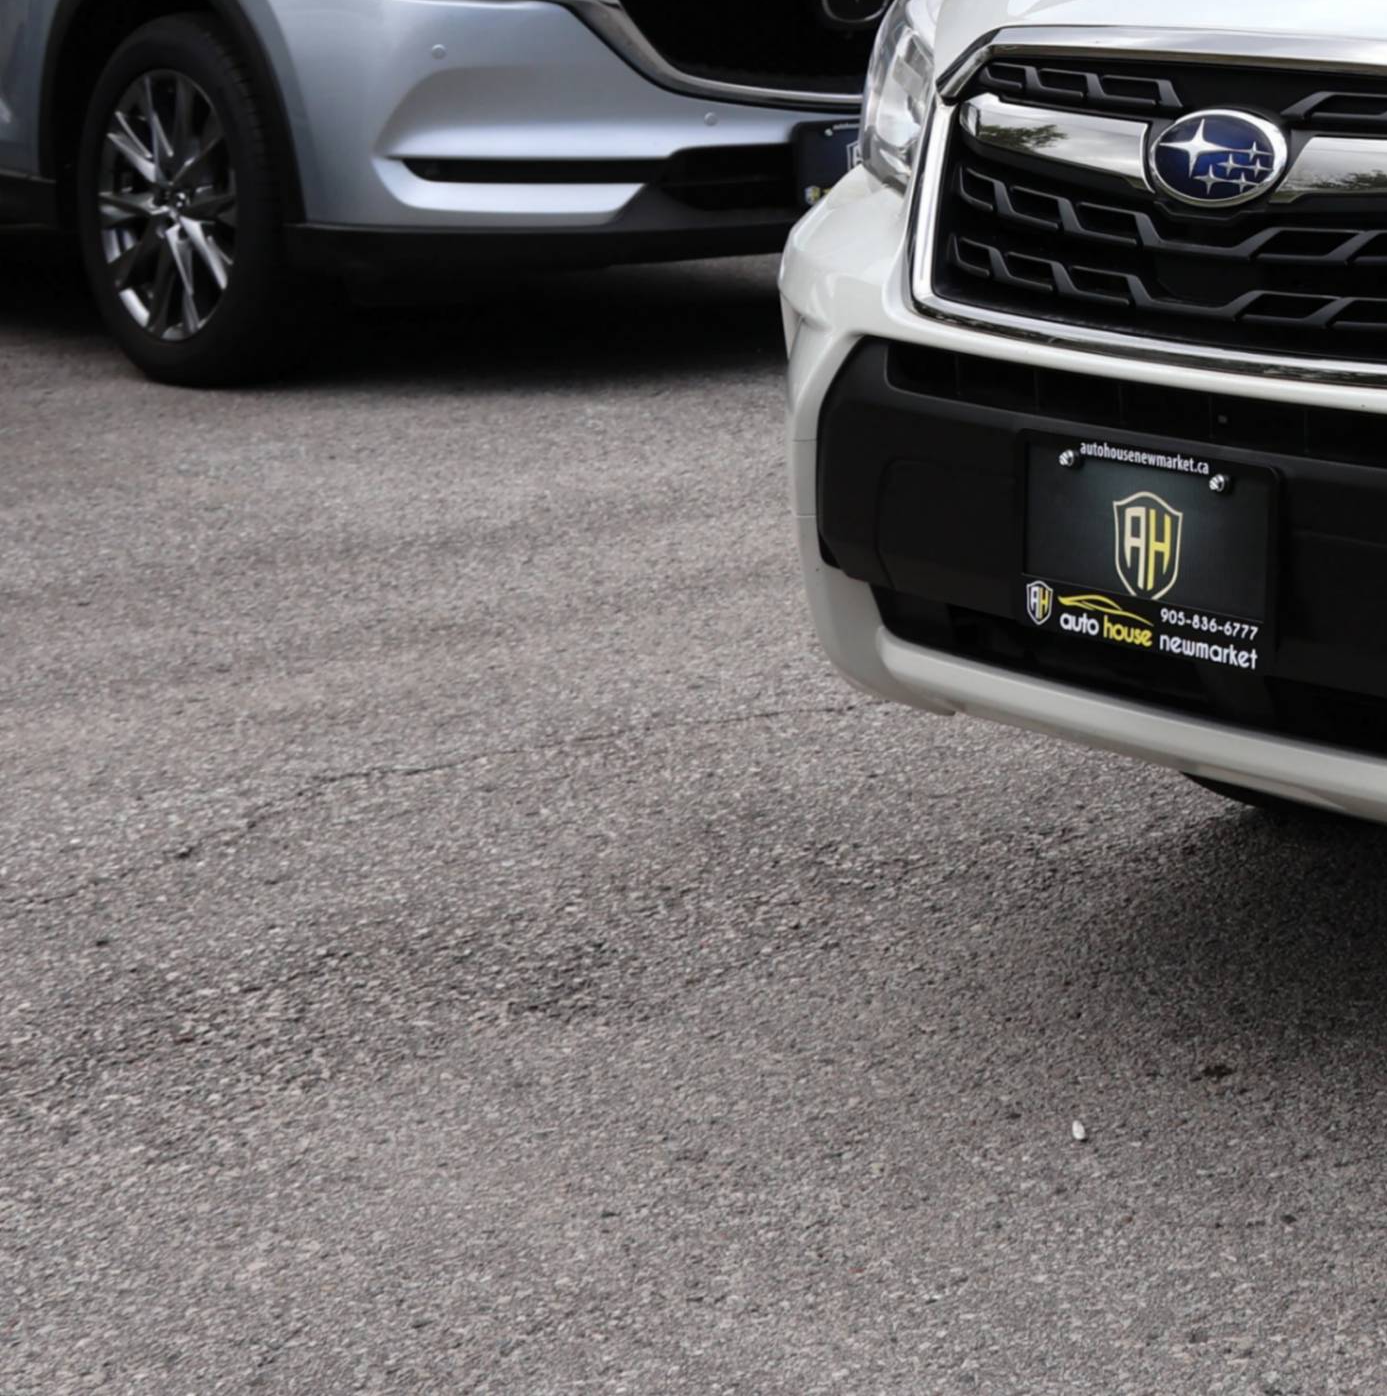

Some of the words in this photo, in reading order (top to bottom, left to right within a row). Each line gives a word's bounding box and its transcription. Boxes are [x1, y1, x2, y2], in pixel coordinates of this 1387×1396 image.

[1080, 442, 1209, 475] autohousenewmarket.ca
[1124, 506, 1172, 591] AH
[1030, 586, 1049, 620] AH
[1060, 612, 1100, 636] auto
[1103, 615, 1153, 647] house
[1159, 633, 1258, 670] newmarket
[1160, 608, 1258, 641] 905-836-6777
